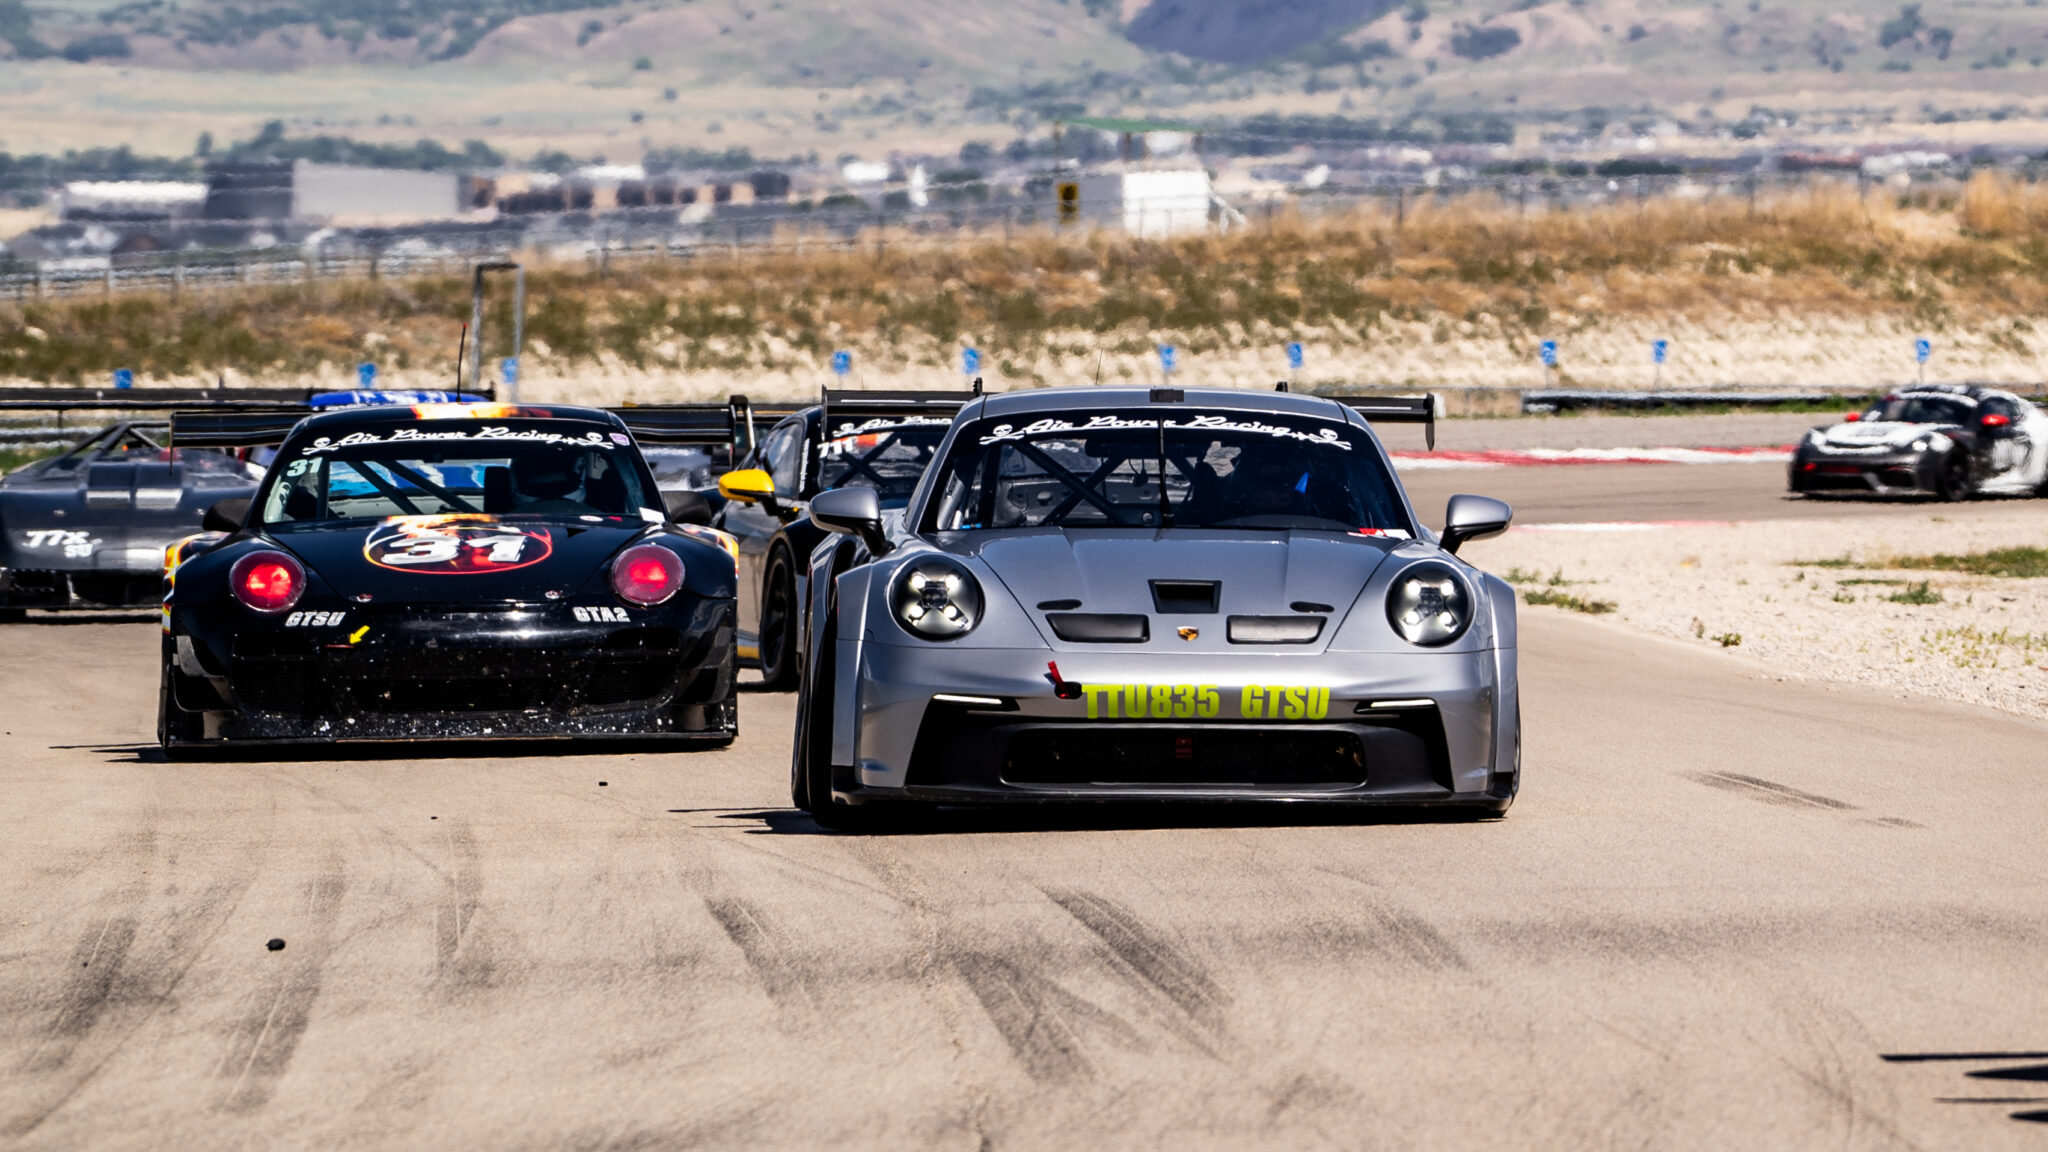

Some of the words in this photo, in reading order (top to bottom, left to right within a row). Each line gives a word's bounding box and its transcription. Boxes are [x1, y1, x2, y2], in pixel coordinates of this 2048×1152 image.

[338, 432, 382, 447] Air
[388, 428, 468, 443] Power
[470, 426, 563, 444] Racing
[1022, 418, 1074, 435] Air
[1083, 415, 1177, 429] Power
[1183, 415, 1292, 437] Racing
[286, 456, 324, 477] 31
[380, 534, 528, 565] 31
[284, 611, 347, 627] GTSU
[572, 606, 631, 623] GTA2
[1081, 683, 1221, 720] TTU835
[1240, 685, 1331, 720] GTSU
